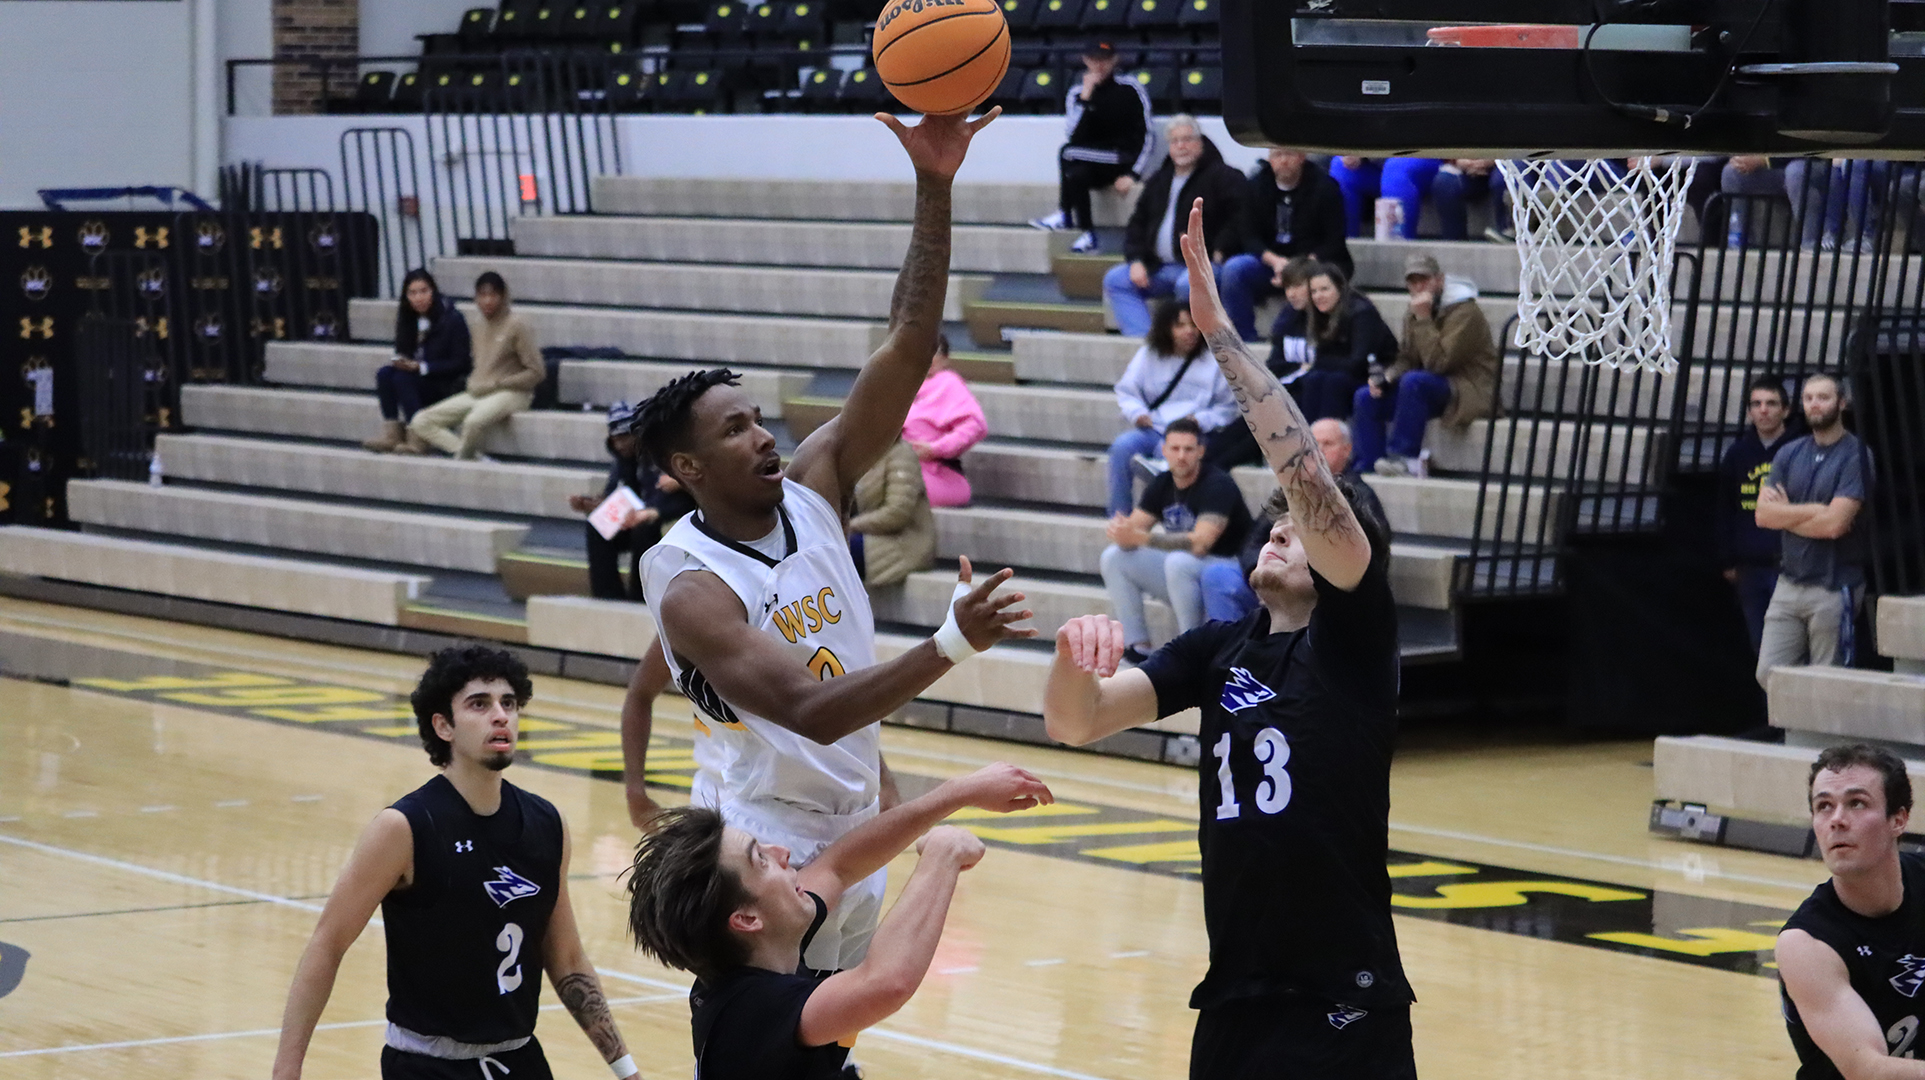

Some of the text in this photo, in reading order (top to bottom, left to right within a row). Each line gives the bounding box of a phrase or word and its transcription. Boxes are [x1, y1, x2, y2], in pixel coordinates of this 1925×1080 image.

[772, 586, 842, 644] WSC
[1212, 727, 1292, 820] 13
[496, 922, 524, 995] 2
